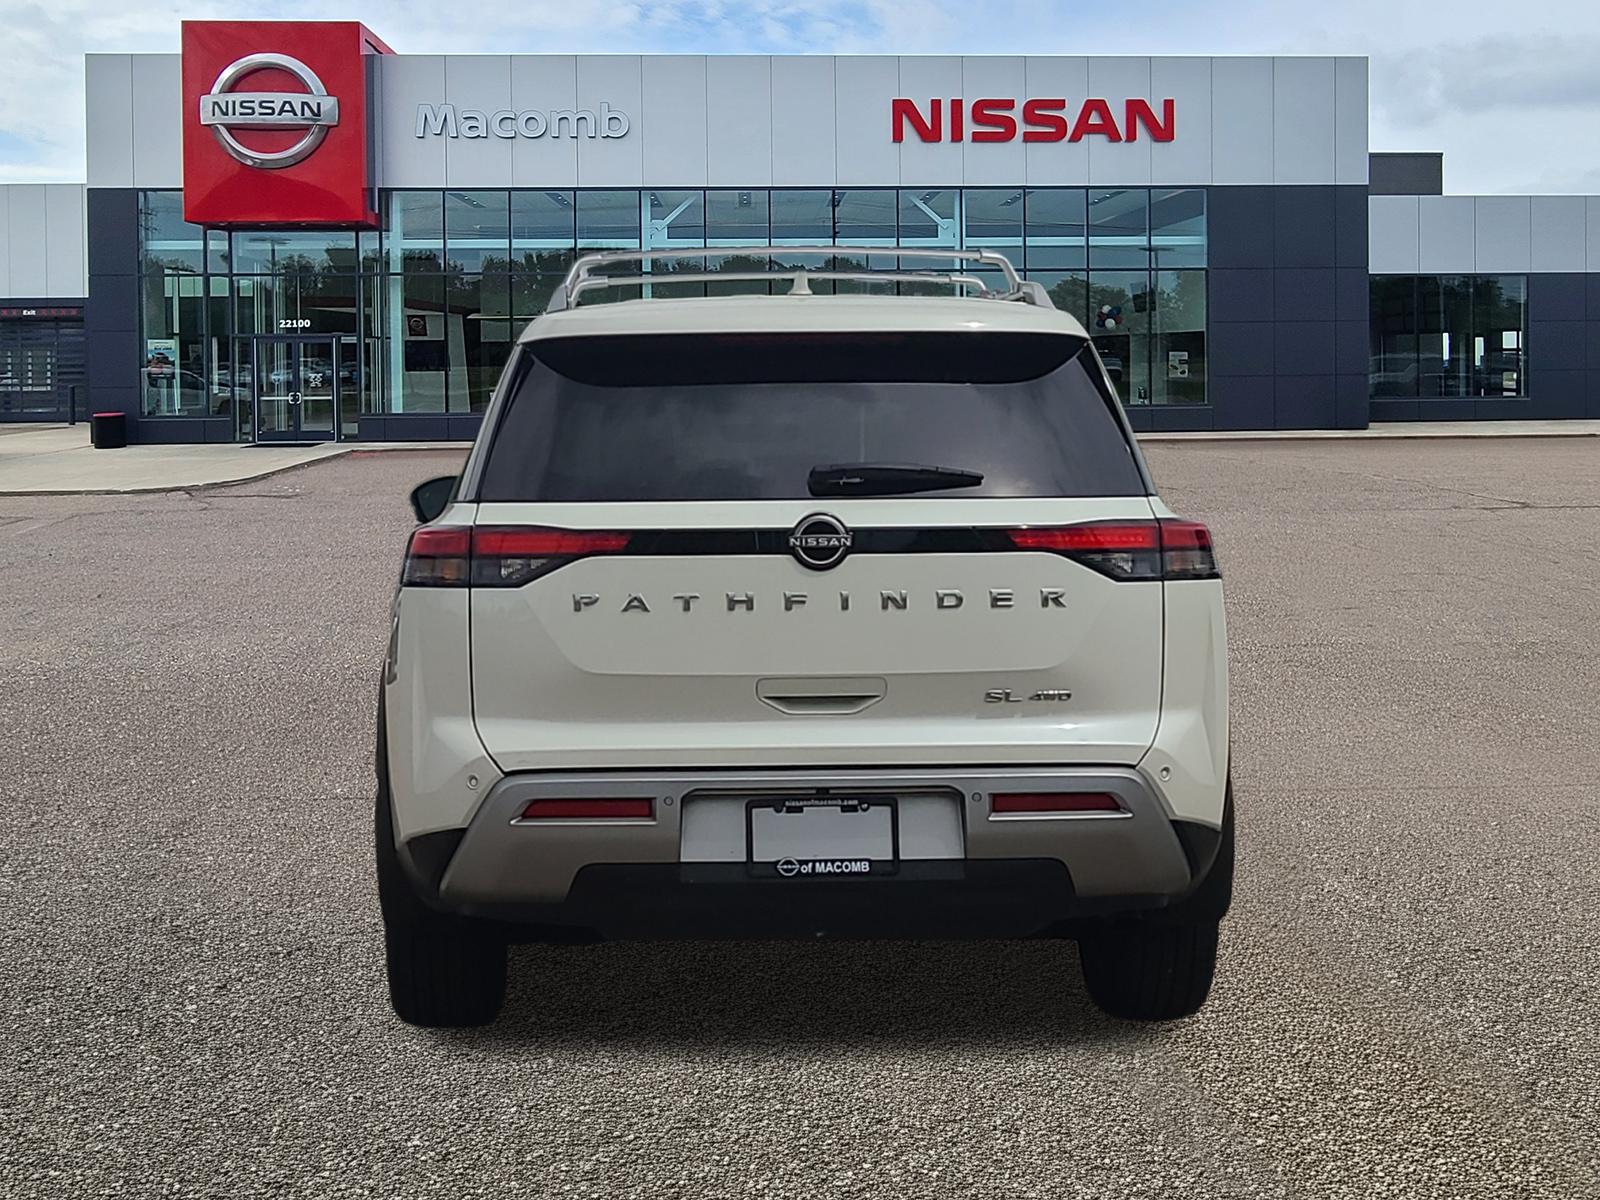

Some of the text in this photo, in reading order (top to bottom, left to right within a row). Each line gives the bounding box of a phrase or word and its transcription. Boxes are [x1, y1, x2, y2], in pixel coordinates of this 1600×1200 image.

[211, 98, 322, 118] NISSAN
[415, 102, 629, 138] Macomb
[892, 98, 1174, 143] NISSAN
[279, 319, 311, 328] 22100
[789, 537, 852, 547] NISSAN
[571, 587, 1068, 614] PATHFINDER
[983, 688, 1071, 703] SL 4WD
[800, 862, 813, 873] of
[815, 861, 870, 873] MACOMB
